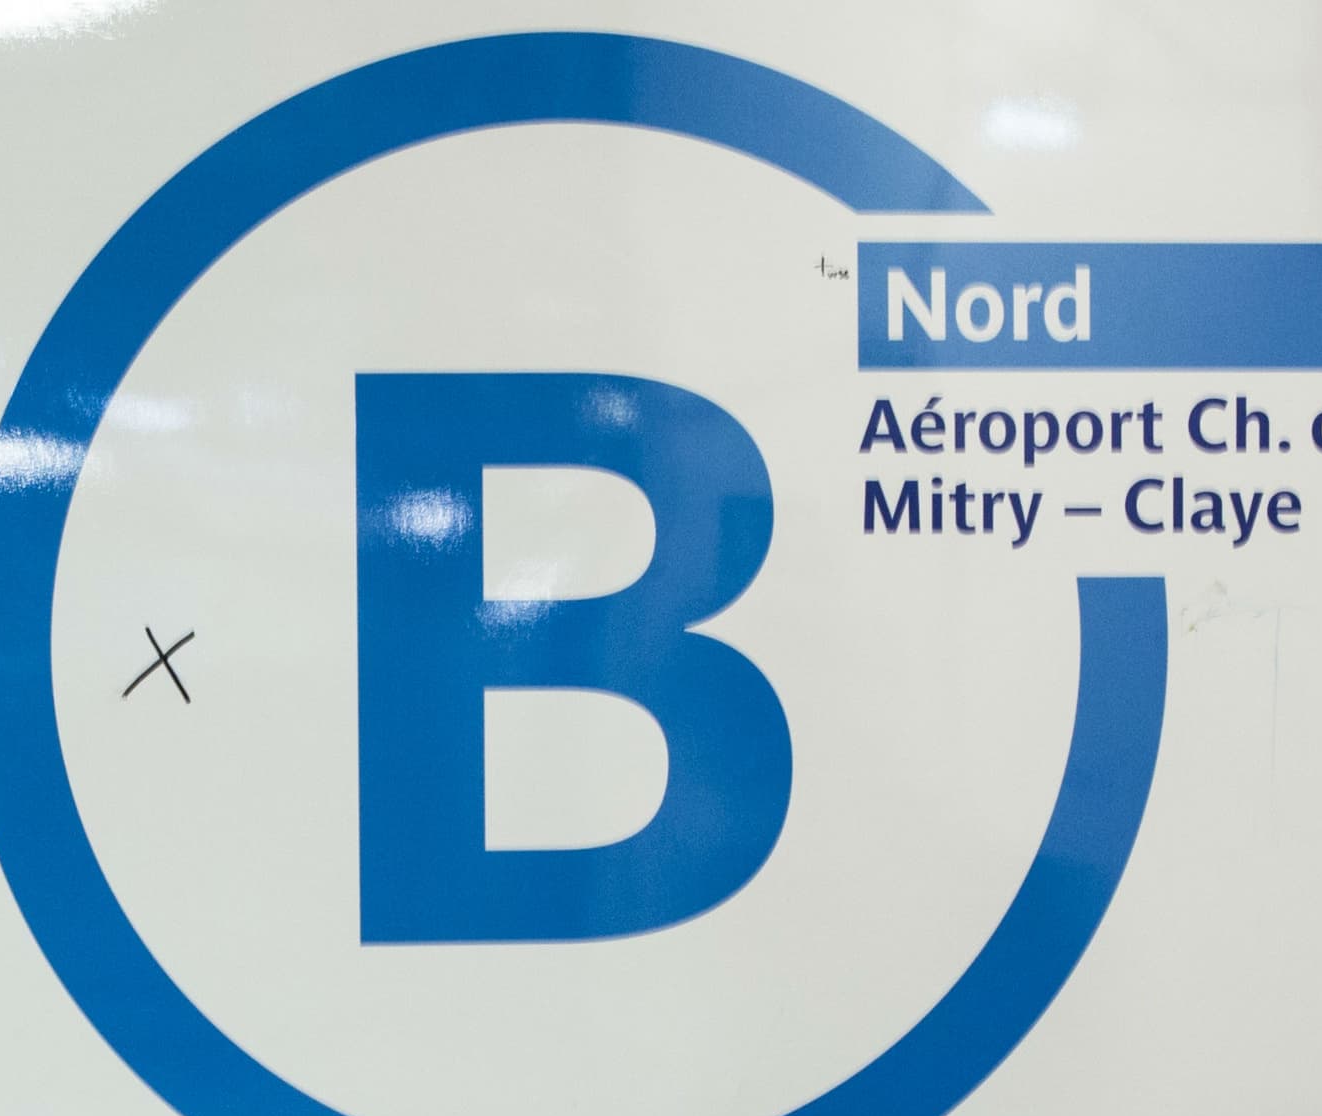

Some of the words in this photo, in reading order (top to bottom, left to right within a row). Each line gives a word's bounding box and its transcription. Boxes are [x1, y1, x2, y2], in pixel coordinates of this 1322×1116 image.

[886, 265, 1091, 342] Nord
[859, 394, 1163, 466] Aéroport
[1187, 396, 1291, 454] Ch.
[863, 476, 1043, 547] Mitry
[1123, 476, 1302, 547] Claye
[355, 372, 793, 945] B
